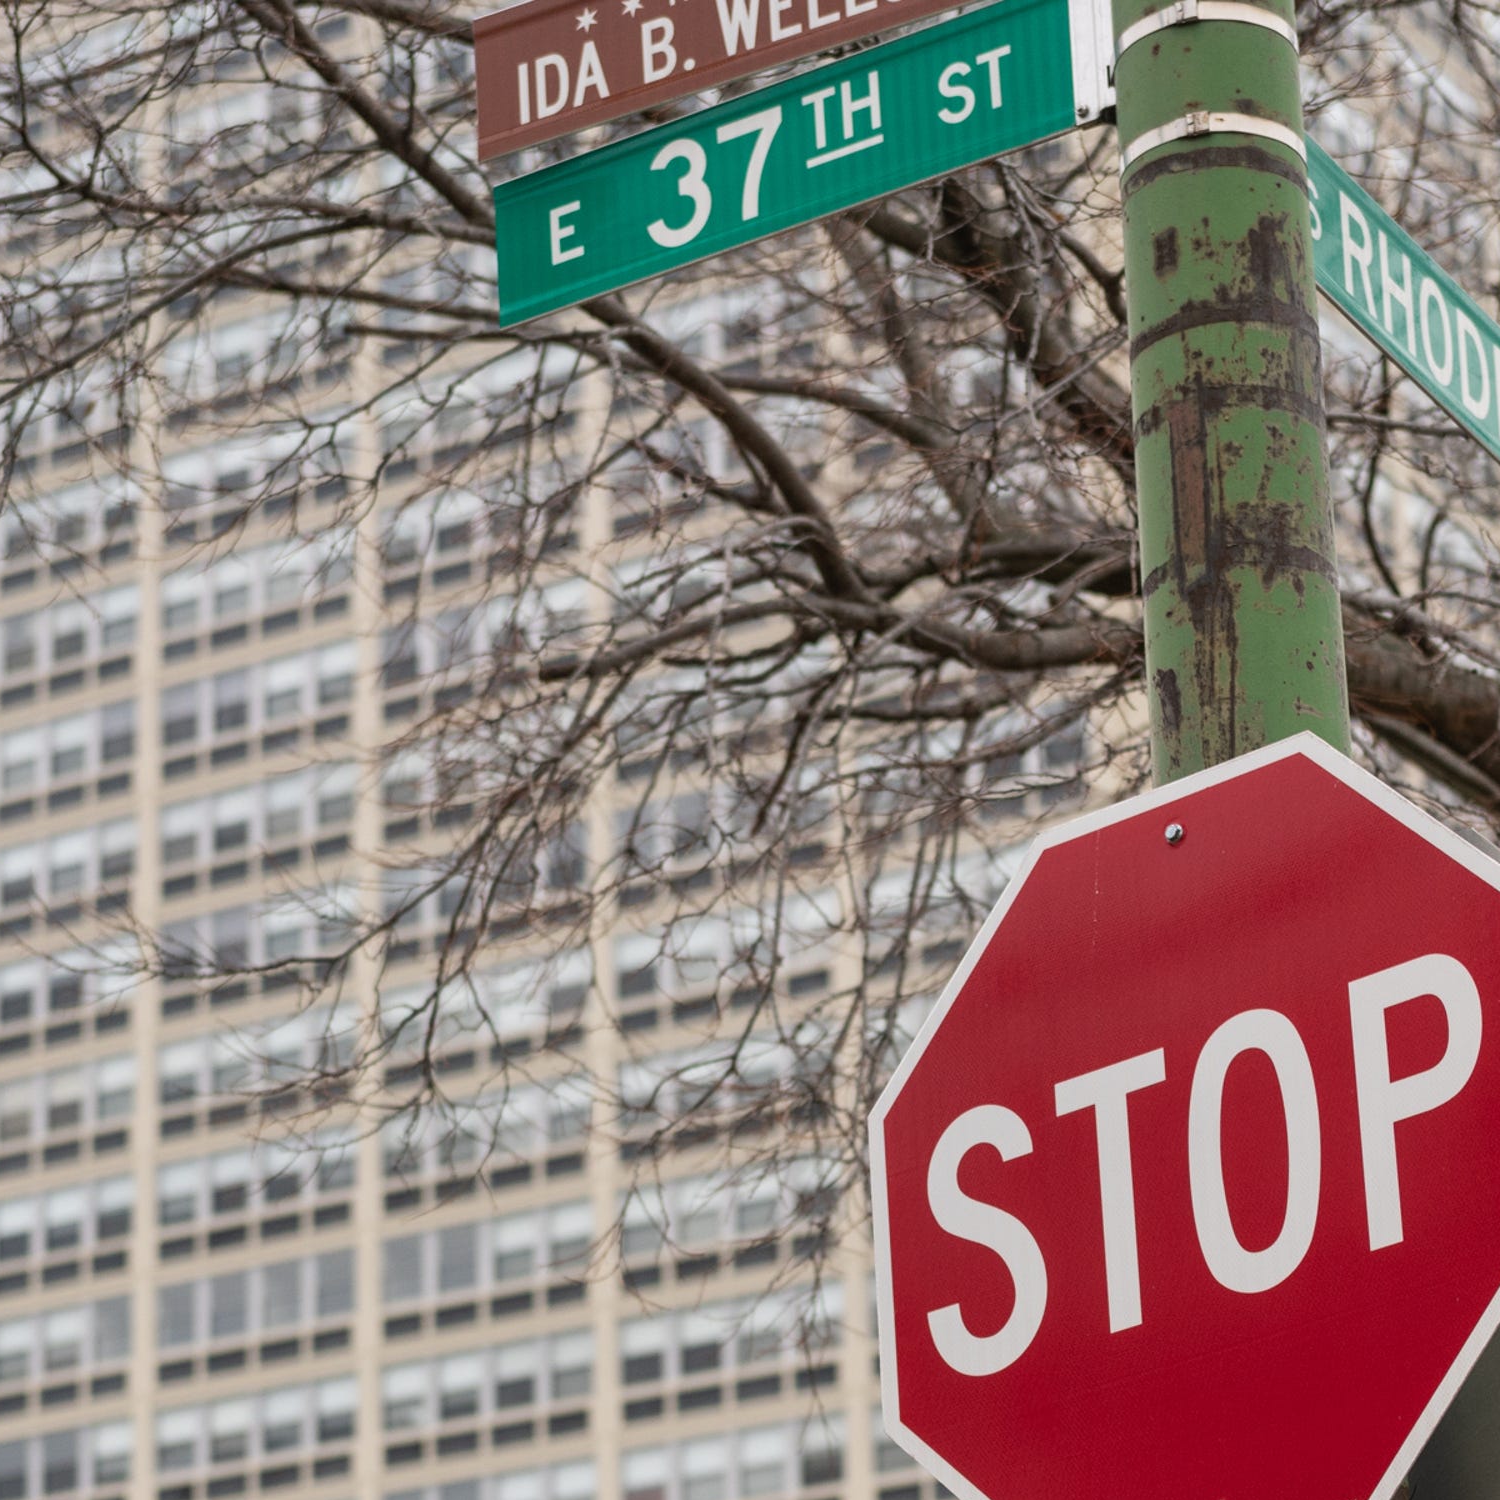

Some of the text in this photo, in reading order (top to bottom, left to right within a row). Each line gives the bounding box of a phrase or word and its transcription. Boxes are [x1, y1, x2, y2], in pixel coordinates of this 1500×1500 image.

[518, 0, 903, 125] IDA B. WEL
[549, 46, 1011, 266] E 37TH ST
[927, 953, 1483, 1377] STOP
